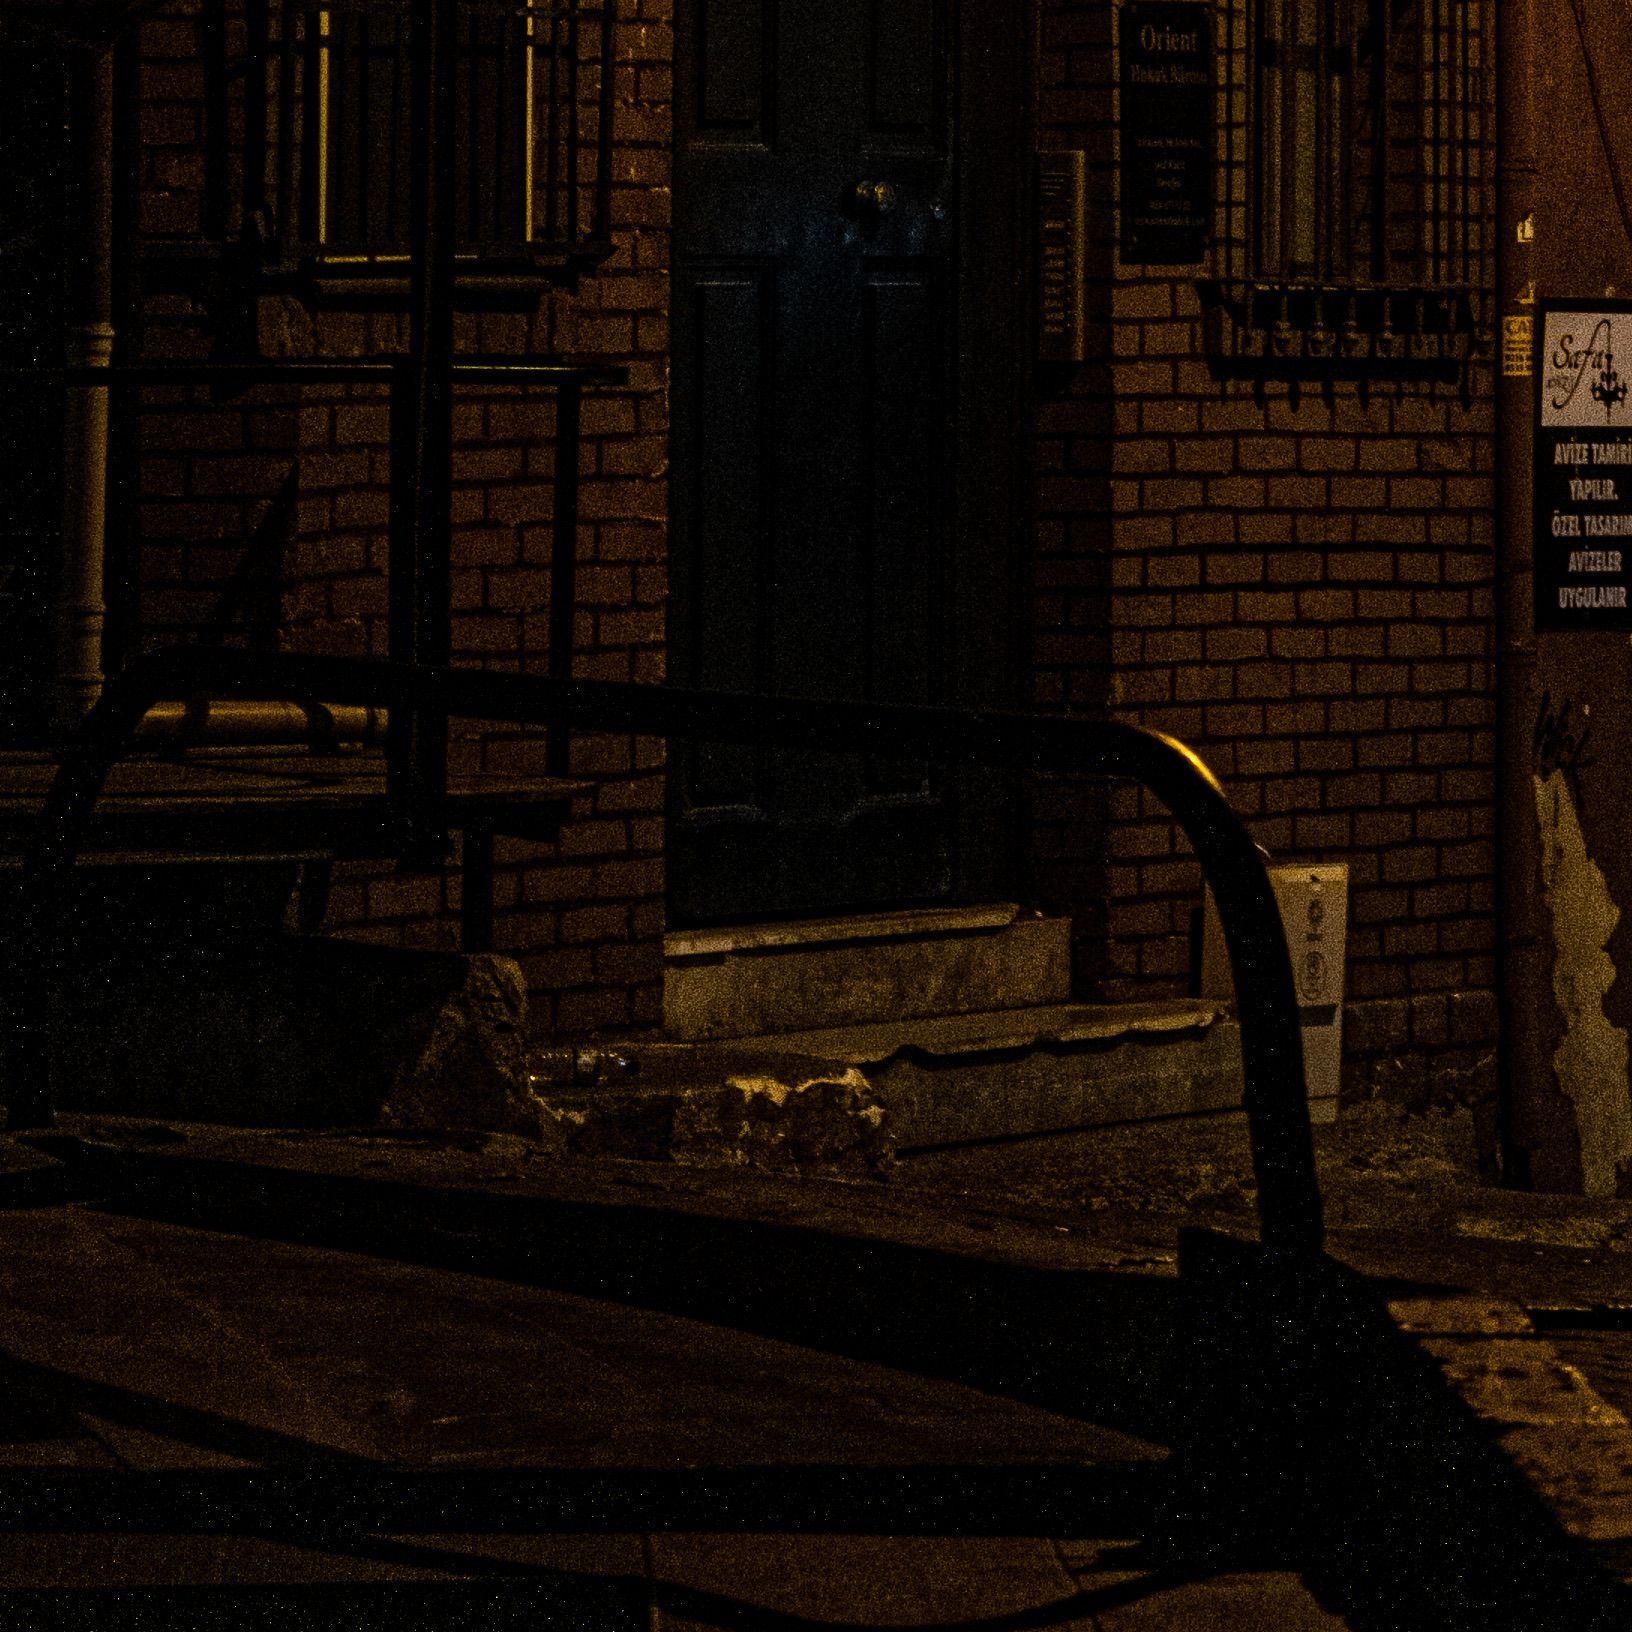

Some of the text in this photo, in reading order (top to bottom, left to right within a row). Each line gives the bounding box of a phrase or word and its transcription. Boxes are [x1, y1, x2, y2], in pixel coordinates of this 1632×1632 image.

[1140, 24, 1198, 52] Orient
[1552, 320, 1614, 410] Safa
[1553, 436, 1632, 465] AVİZE TAMİRİ
[1568, 478, 1619, 501] YAPILIR.
[1551, 509, 1582, 537] ÖZEL
[1568, 544, 1623, 573] AVİZELER
[1558, 586, 1627, 609] UYGULANIR
